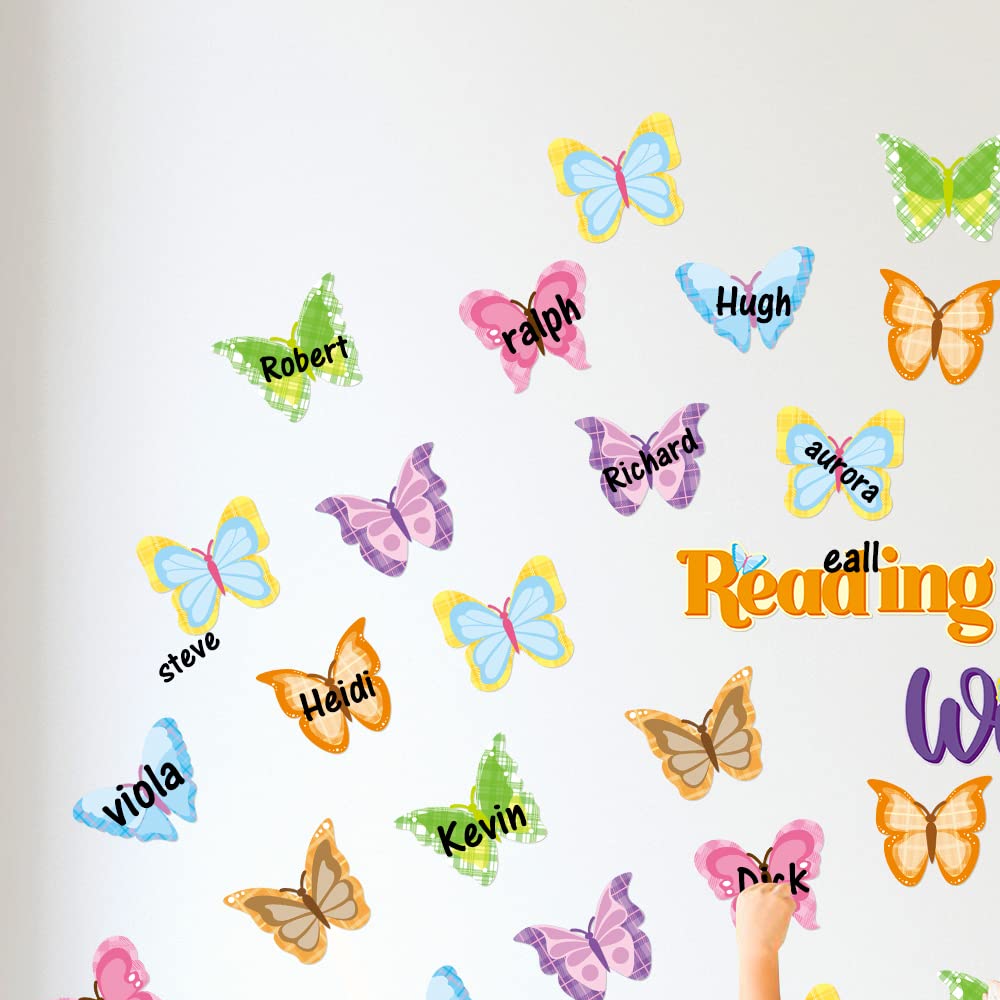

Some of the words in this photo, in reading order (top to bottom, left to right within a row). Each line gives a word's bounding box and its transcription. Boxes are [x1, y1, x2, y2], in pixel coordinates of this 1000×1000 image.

[501, 294, 582, 354] ralph
[716, 285, 791, 324] Hugh
[259, 335, 349, 383] Robert
[602, 427, 699, 494] Richard
[804, 441, 879, 504] aurora
[823, 540, 880, 573] eall
[676, 546, 996, 646] Reading
[159, 632, 220, 683] steve
[299, 670, 380, 722] Heidi
[102, 762, 185, 826] viola
[437, 804, 527, 857] Kevin
